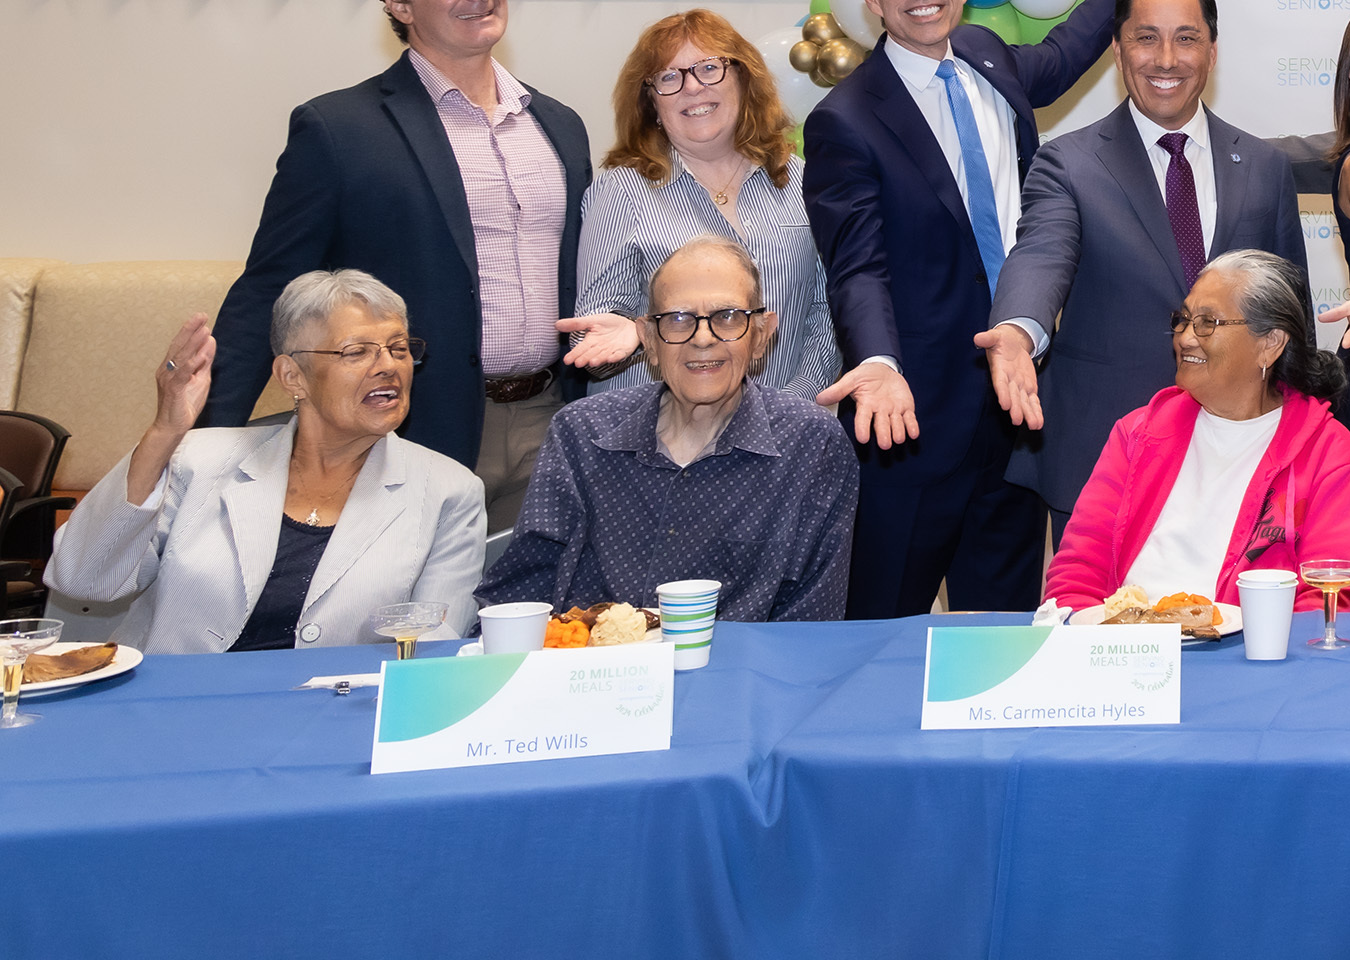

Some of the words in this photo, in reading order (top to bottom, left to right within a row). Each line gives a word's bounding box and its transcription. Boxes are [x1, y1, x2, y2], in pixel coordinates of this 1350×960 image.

[1277, 58, 1338, 71] SERVIN
[1090, 645, 1104, 654] 20
[1108, 644, 1159, 654] MILLION
[1090, 656, 1128, 666] MEALS
[569, 669, 585, 681] 20
[590, 665, 649, 679] MILLION
[569, 681, 613, 693] MEALS
[969, 706, 996, 720] Ms.
[1003, 704, 1096, 720] Carmencita
[1102, 703, 1145, 721] Hyles
[467, 742, 497, 757] Mr.
[505, 737, 538, 754] Ted
[545, 733, 588, 750] Wills
